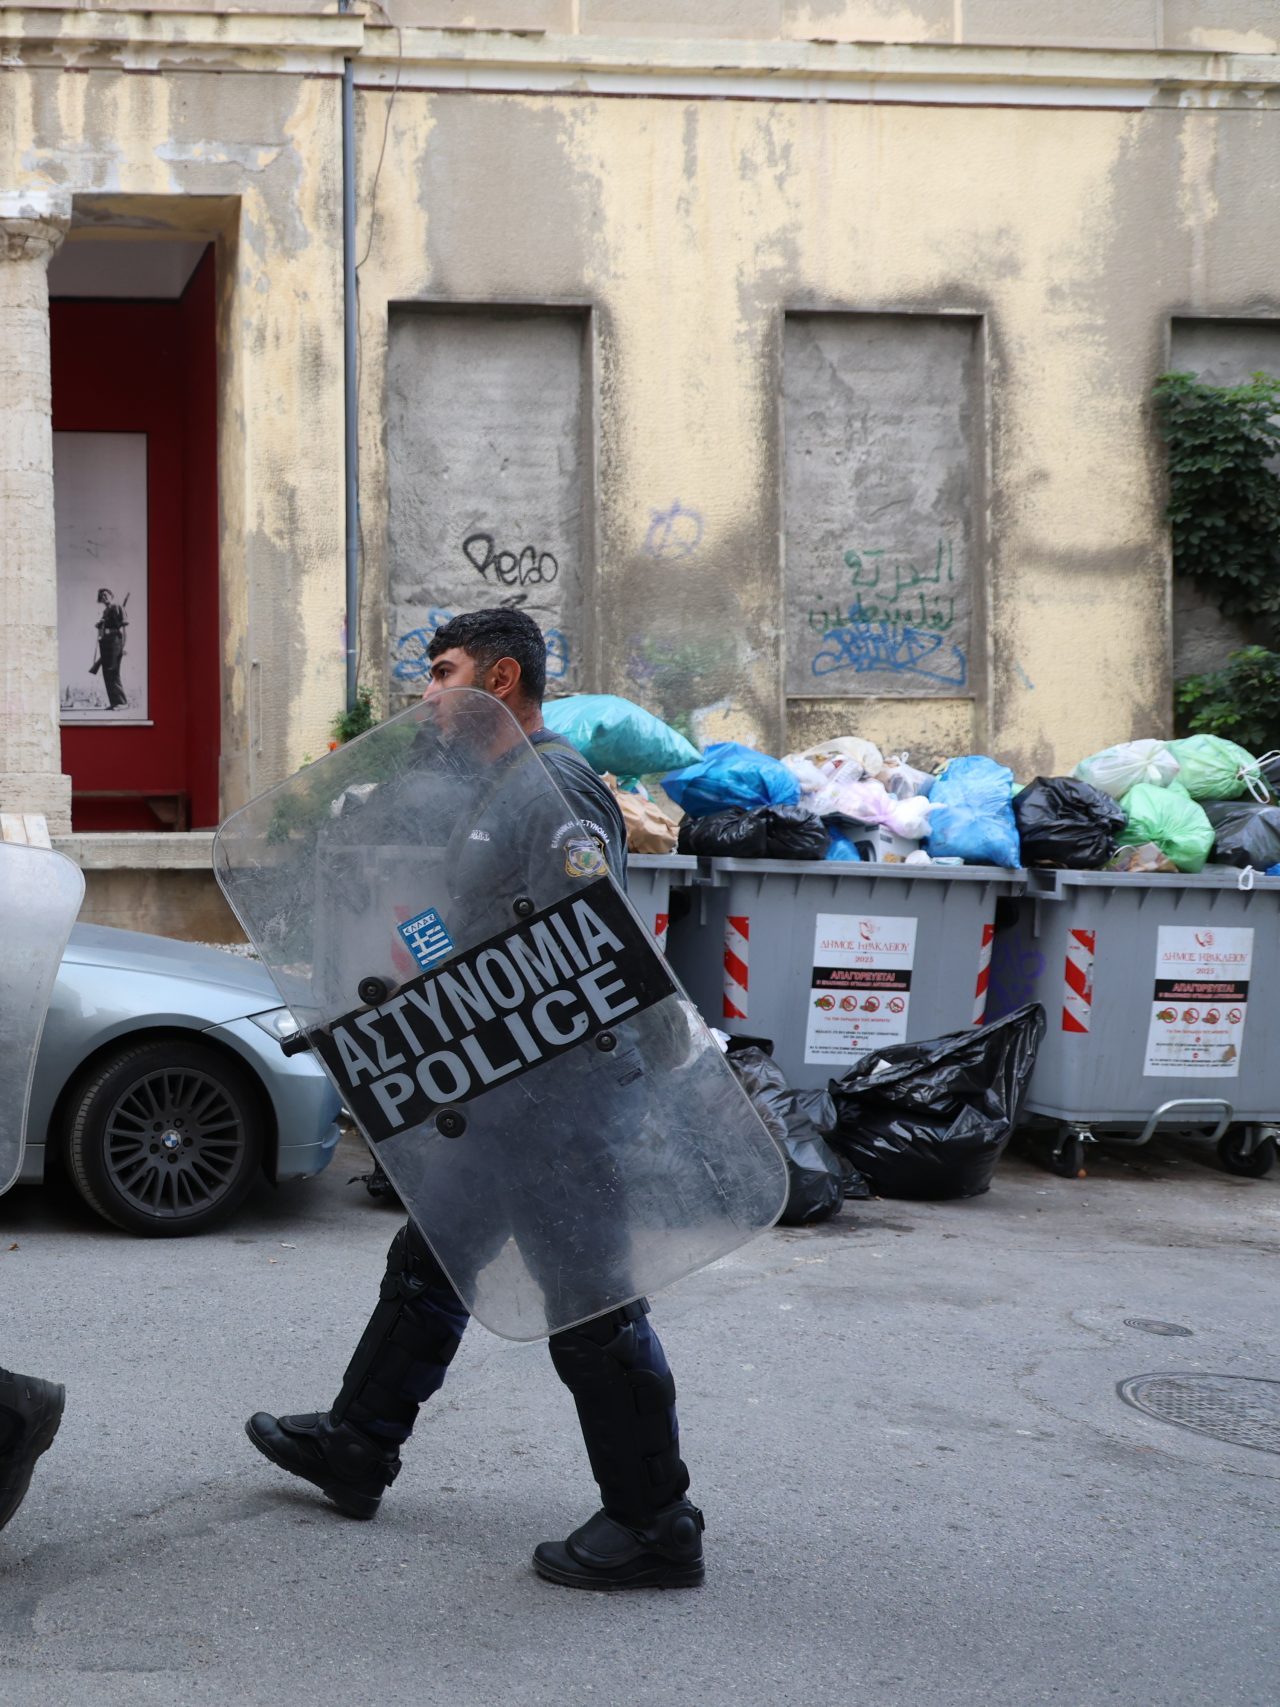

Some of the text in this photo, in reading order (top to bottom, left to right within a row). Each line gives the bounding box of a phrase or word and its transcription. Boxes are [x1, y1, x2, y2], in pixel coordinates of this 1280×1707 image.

[331, 899, 625, 1087] ΑΣΤΥΝΟΜΙΑ
[820, 940, 855, 950] ΔΗΜΟΣ
[369, 960, 639, 1128] POLICE
